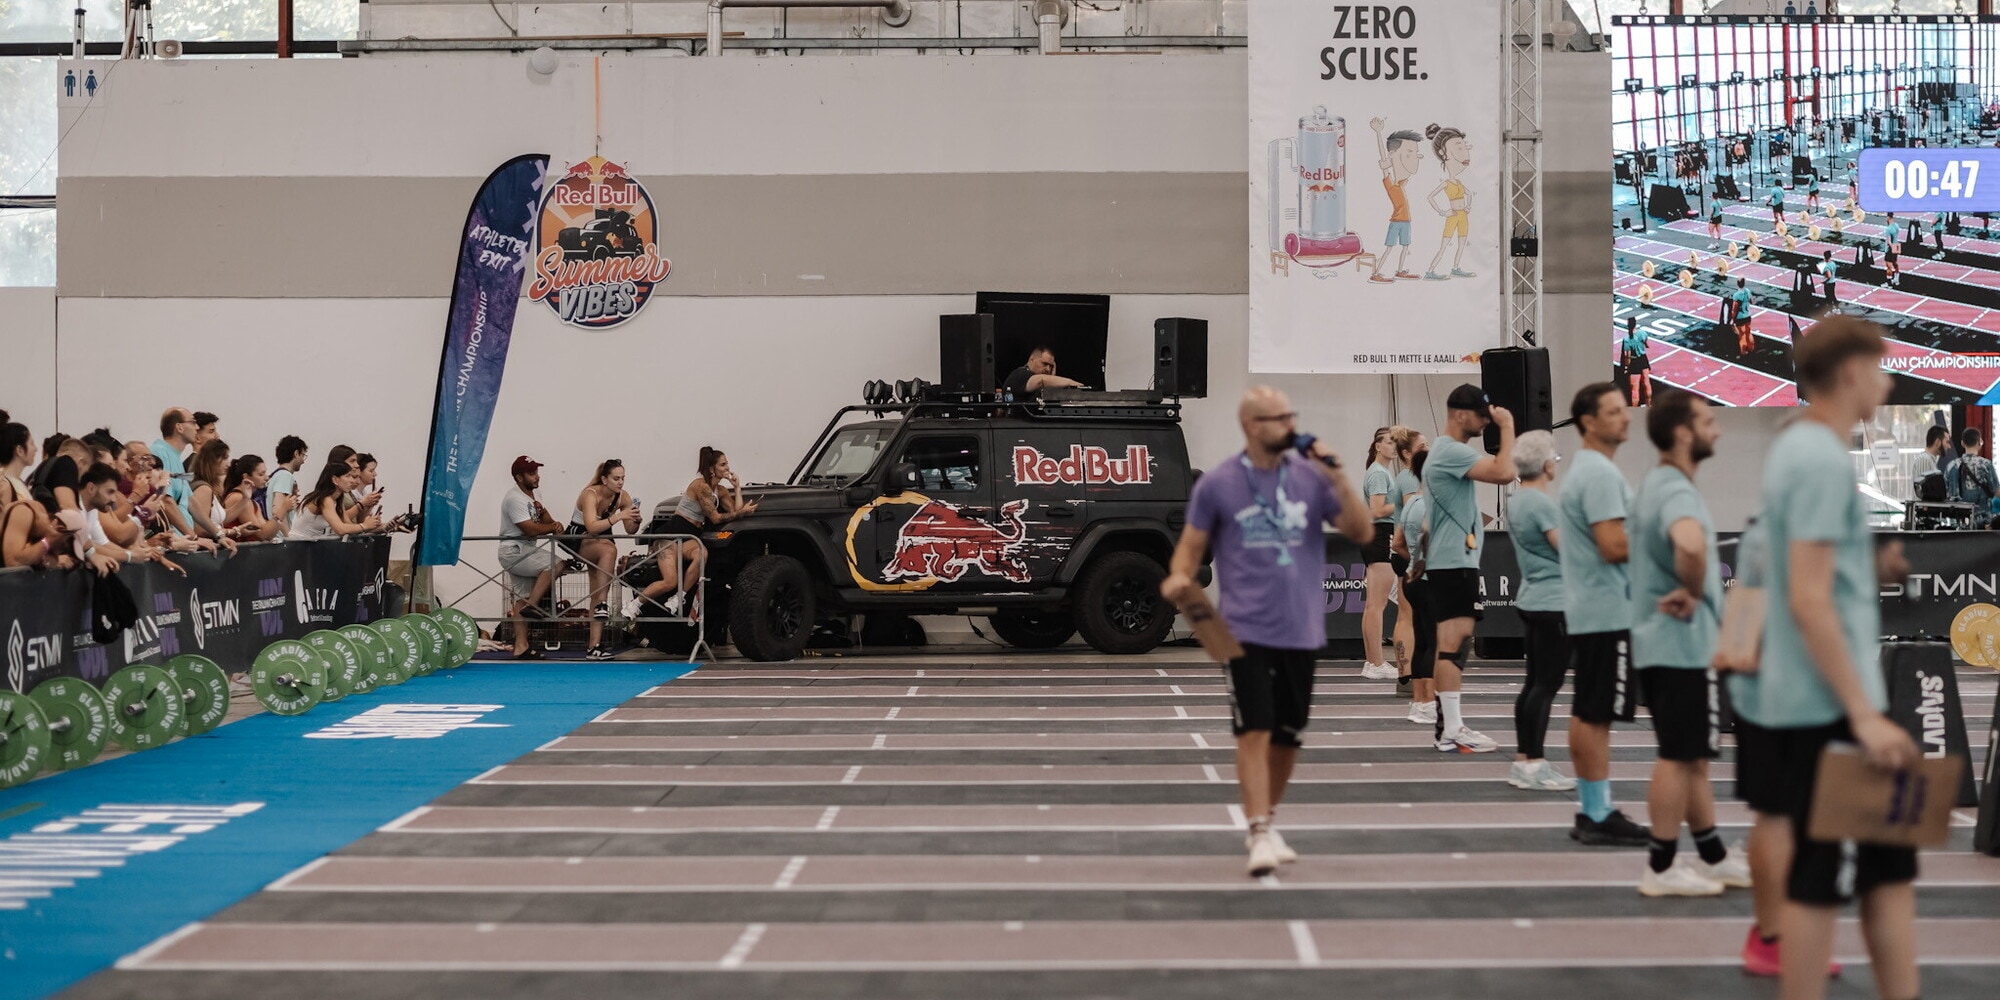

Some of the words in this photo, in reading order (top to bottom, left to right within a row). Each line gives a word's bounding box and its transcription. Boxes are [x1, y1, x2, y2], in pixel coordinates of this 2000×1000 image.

[1333, 5, 1416, 39] ZERO
[1320, 46, 1428, 80] SCUSE.
[1300, 166, 1321, 180] Red
[1324, 165, 1345, 180] Bull
[1885, 160, 1980, 198] 00:47
[555, 184, 595, 205] Red
[599, 184, 638, 205] Bull
[479, 249, 512, 272] EXIT
[529, 244, 671, 301] Summer
[561, 283, 636, 321] VIBES
[456, 291, 488, 396] CHAMPIONSHIP
[1353, 354, 1367, 363] RED
[1370, 354, 1387, 363] BULL
[1390, 354, 1396, 363] TI
[1399, 354, 1421, 363] METTE
[1424, 354, 1431, 363] LE
[1434, 354, 1457, 363] AAALI.
[1880, 357, 1906, 369] LIAN
[1014, 445, 1083, 484] Red
[1084, 445, 1150, 484] Bull
[1322, 580, 1367, 590] HAMPION
[1479, 599, 1508, 607] oftware
[202, 598, 239, 629] STMN
[385, 624, 392, 632] 10
[315, 637, 324, 645] 10
[27, 633, 62, 671] STMN
[194, 663, 204, 673] 10
[257, 671, 266, 679] 10
[56, 684, 66, 696] 10
[136, 734, 145, 744] 10
[63, 751, 73, 763] 10
